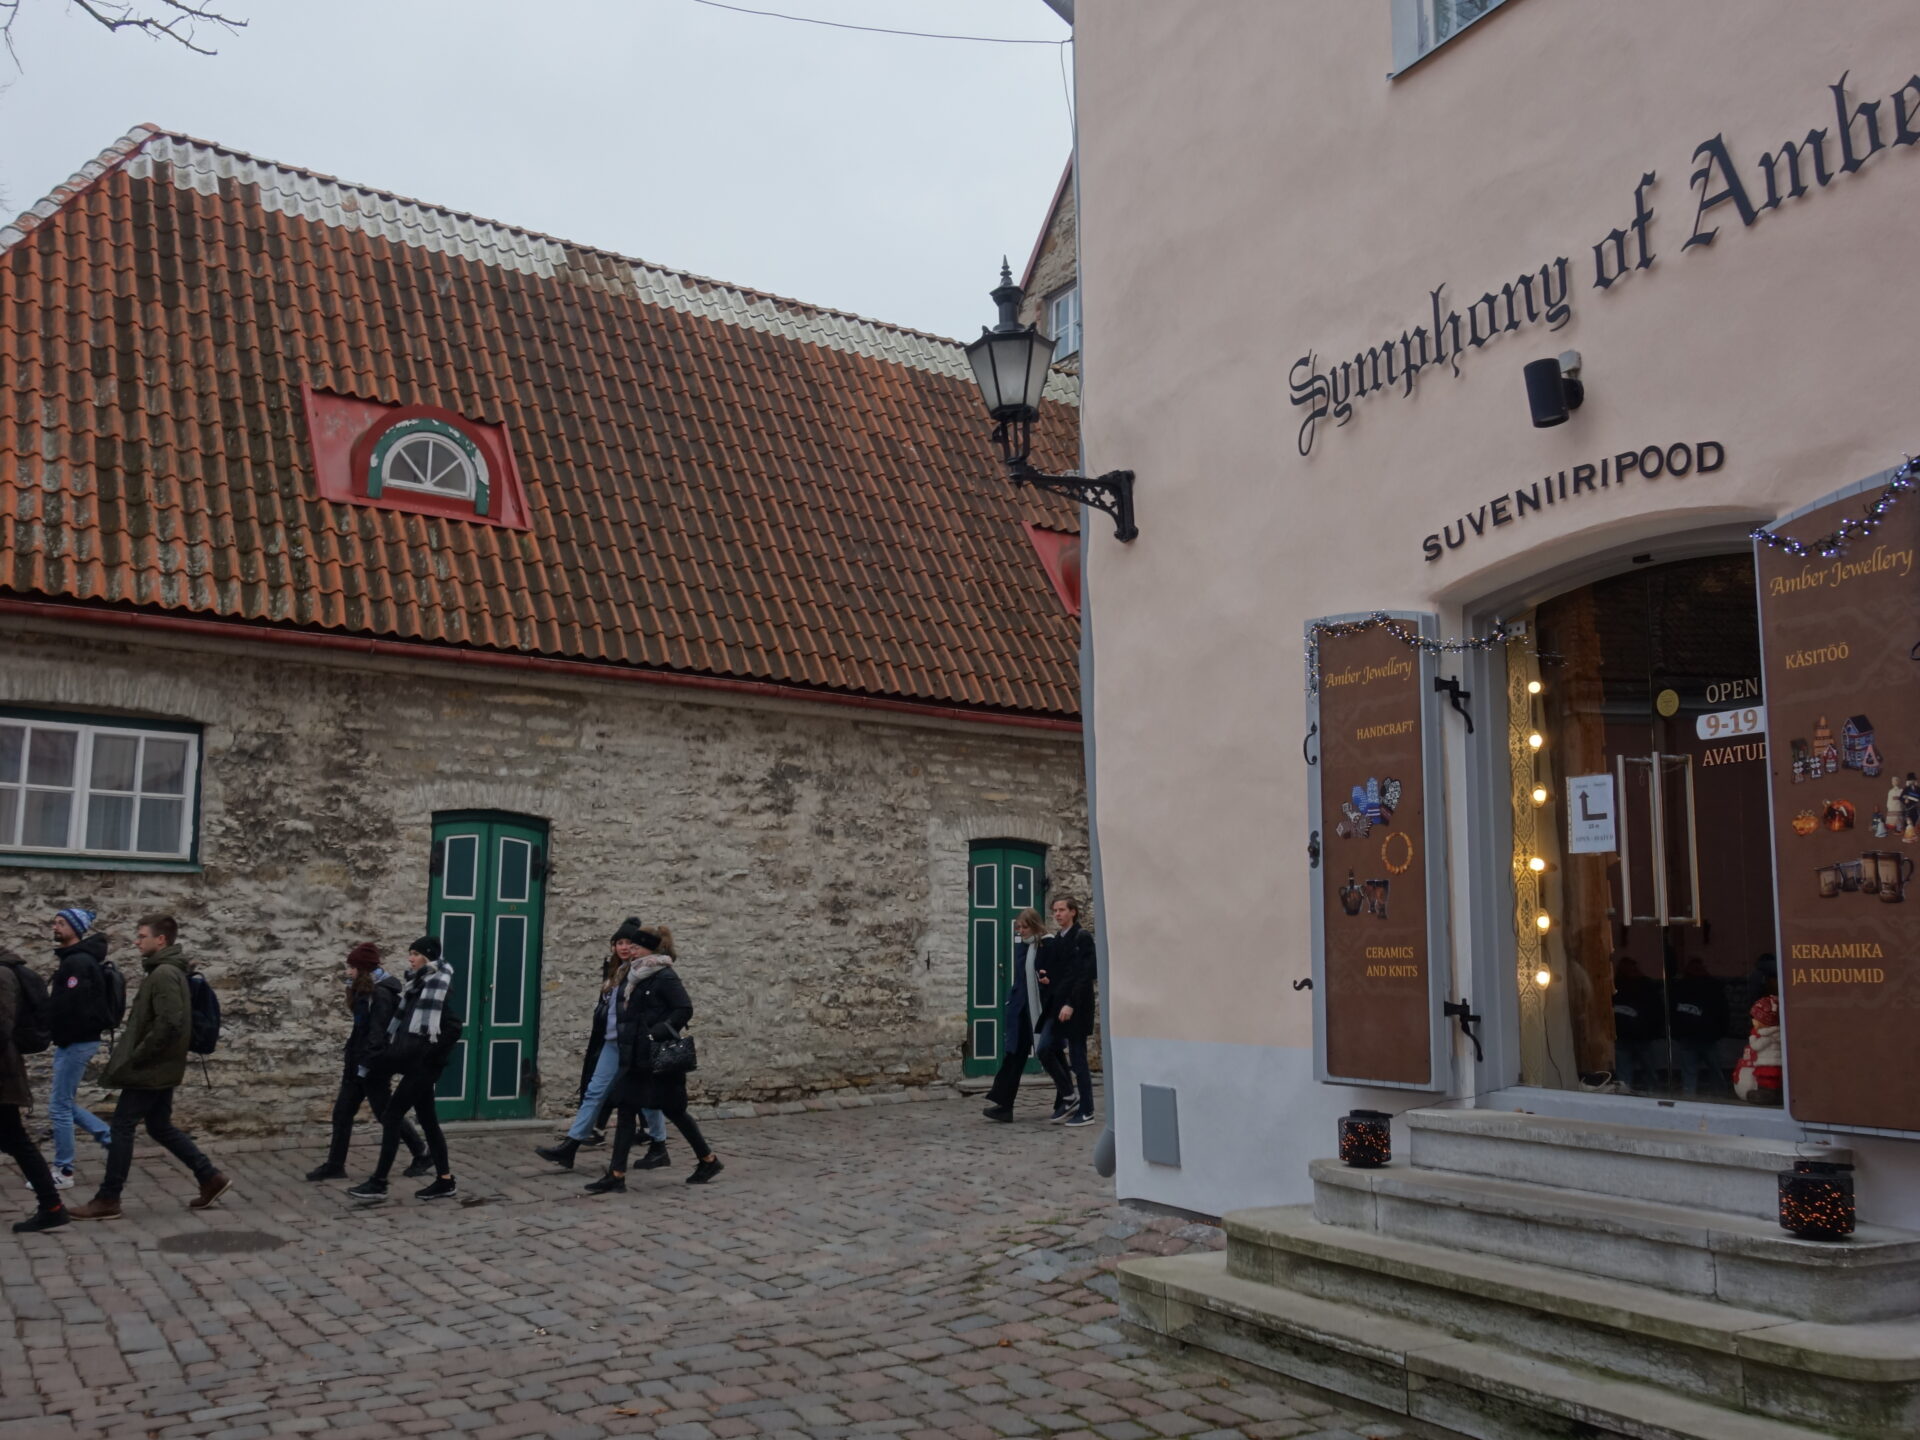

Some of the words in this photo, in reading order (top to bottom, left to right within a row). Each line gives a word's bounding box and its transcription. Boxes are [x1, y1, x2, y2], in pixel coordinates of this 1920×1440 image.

[1289, 256, 1571, 457] Symphony
[1592, 170, 1657, 290] of
[1422, 441, 1726, 562] SUVENIIRIPOOD
[1769, 564, 1829, 597] Amber
[1830, 545, 1913, 588] Jewellery
[1324, 666, 1361, 689] Amber
[1362, 656, 1412, 685] Jewellery
[1706, 677, 1759, 704] OPEN
[1356, 720, 1414, 740] HANDCRAFT
[1706, 709, 1758, 737] 9-19
[1366, 946, 1414, 959] CERAMICS
[1791, 943, 1884, 959] KERAAMIKA
[1366, 965, 1387, 977] AND
[1389, 965, 1418, 977] KNITS
[1791, 968, 1807, 986] JA
[1810, 968, 1884, 983] KUDUMID
